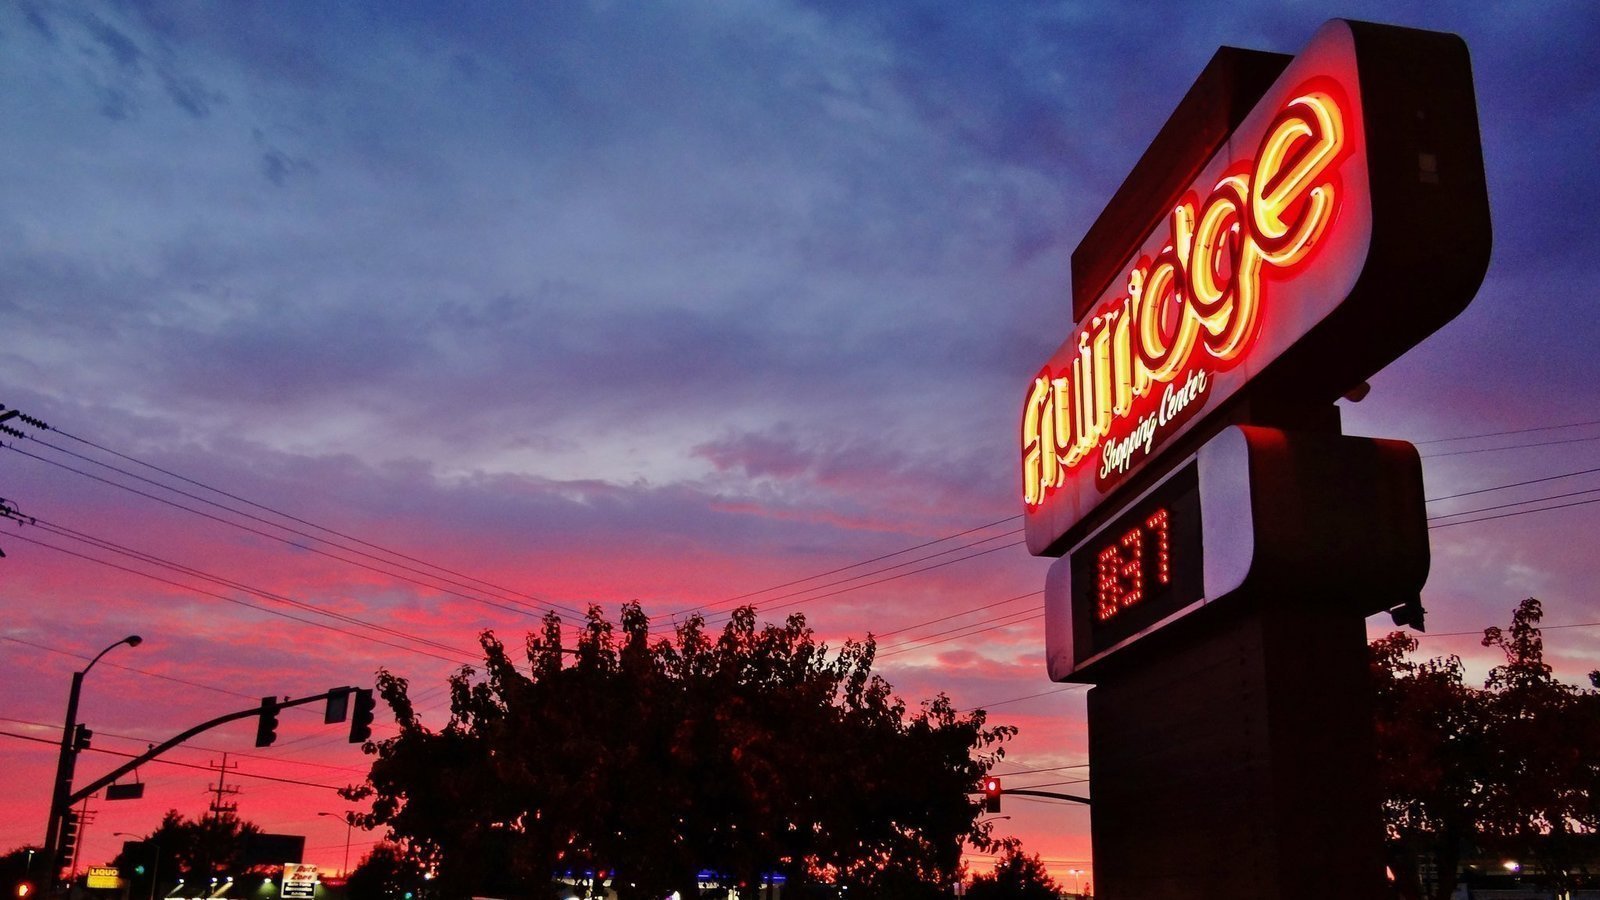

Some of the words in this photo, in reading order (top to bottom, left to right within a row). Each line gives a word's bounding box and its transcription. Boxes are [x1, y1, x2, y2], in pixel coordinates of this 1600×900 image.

[1100, 411, 1157, 479] Shopping
[1159, 369, 1208, 427] Center
[90, 868, 119, 876] LIQUO
